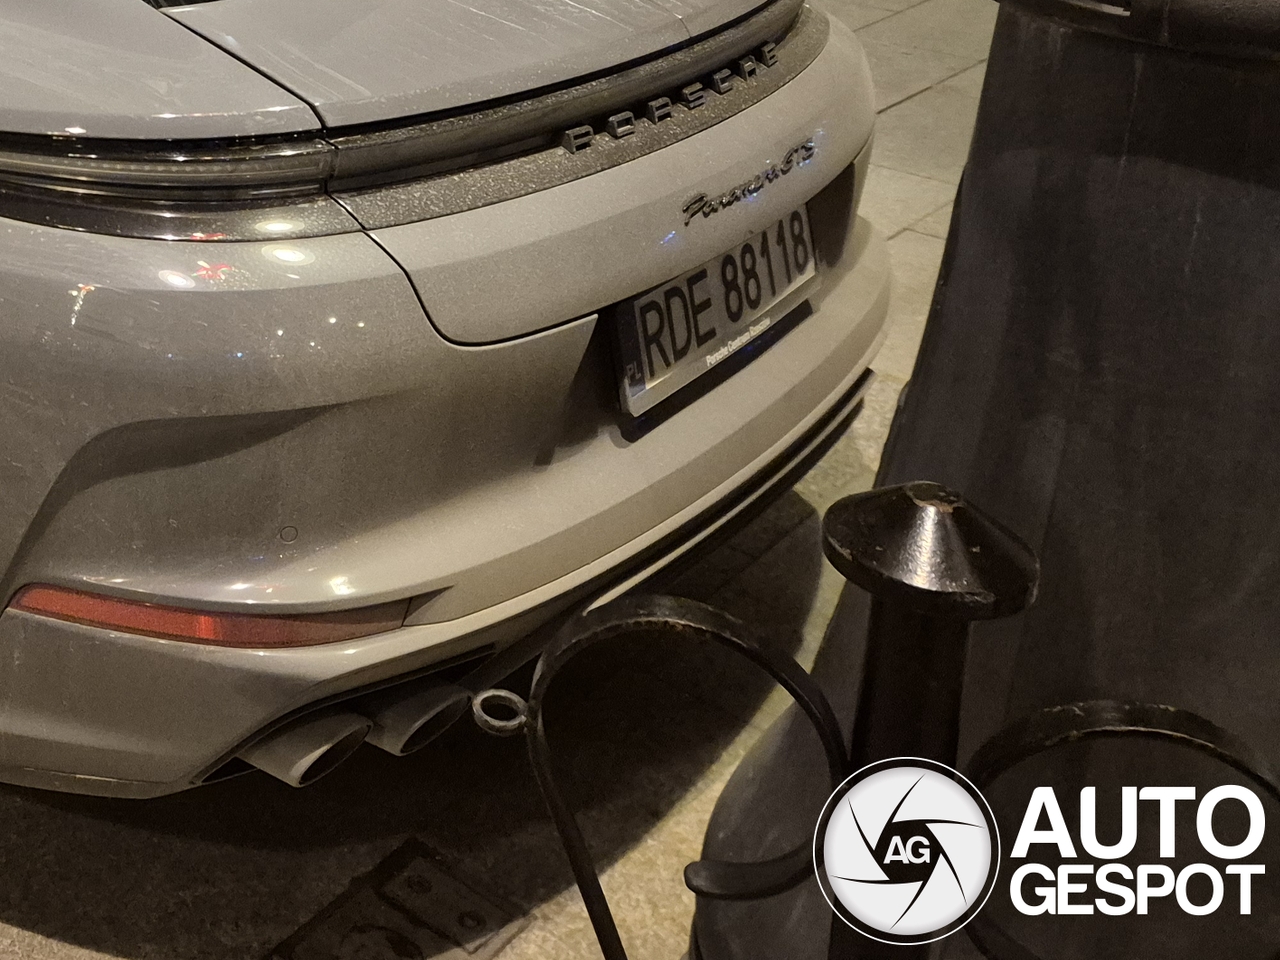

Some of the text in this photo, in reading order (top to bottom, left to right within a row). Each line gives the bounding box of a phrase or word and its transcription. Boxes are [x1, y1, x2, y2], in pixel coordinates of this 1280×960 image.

[564, 43, 778, 155] PORSCHE
[682, 163, 780, 227] Panamera
[639, 210, 808, 378] RDE 88118
[626, 361, 642, 384] PL
